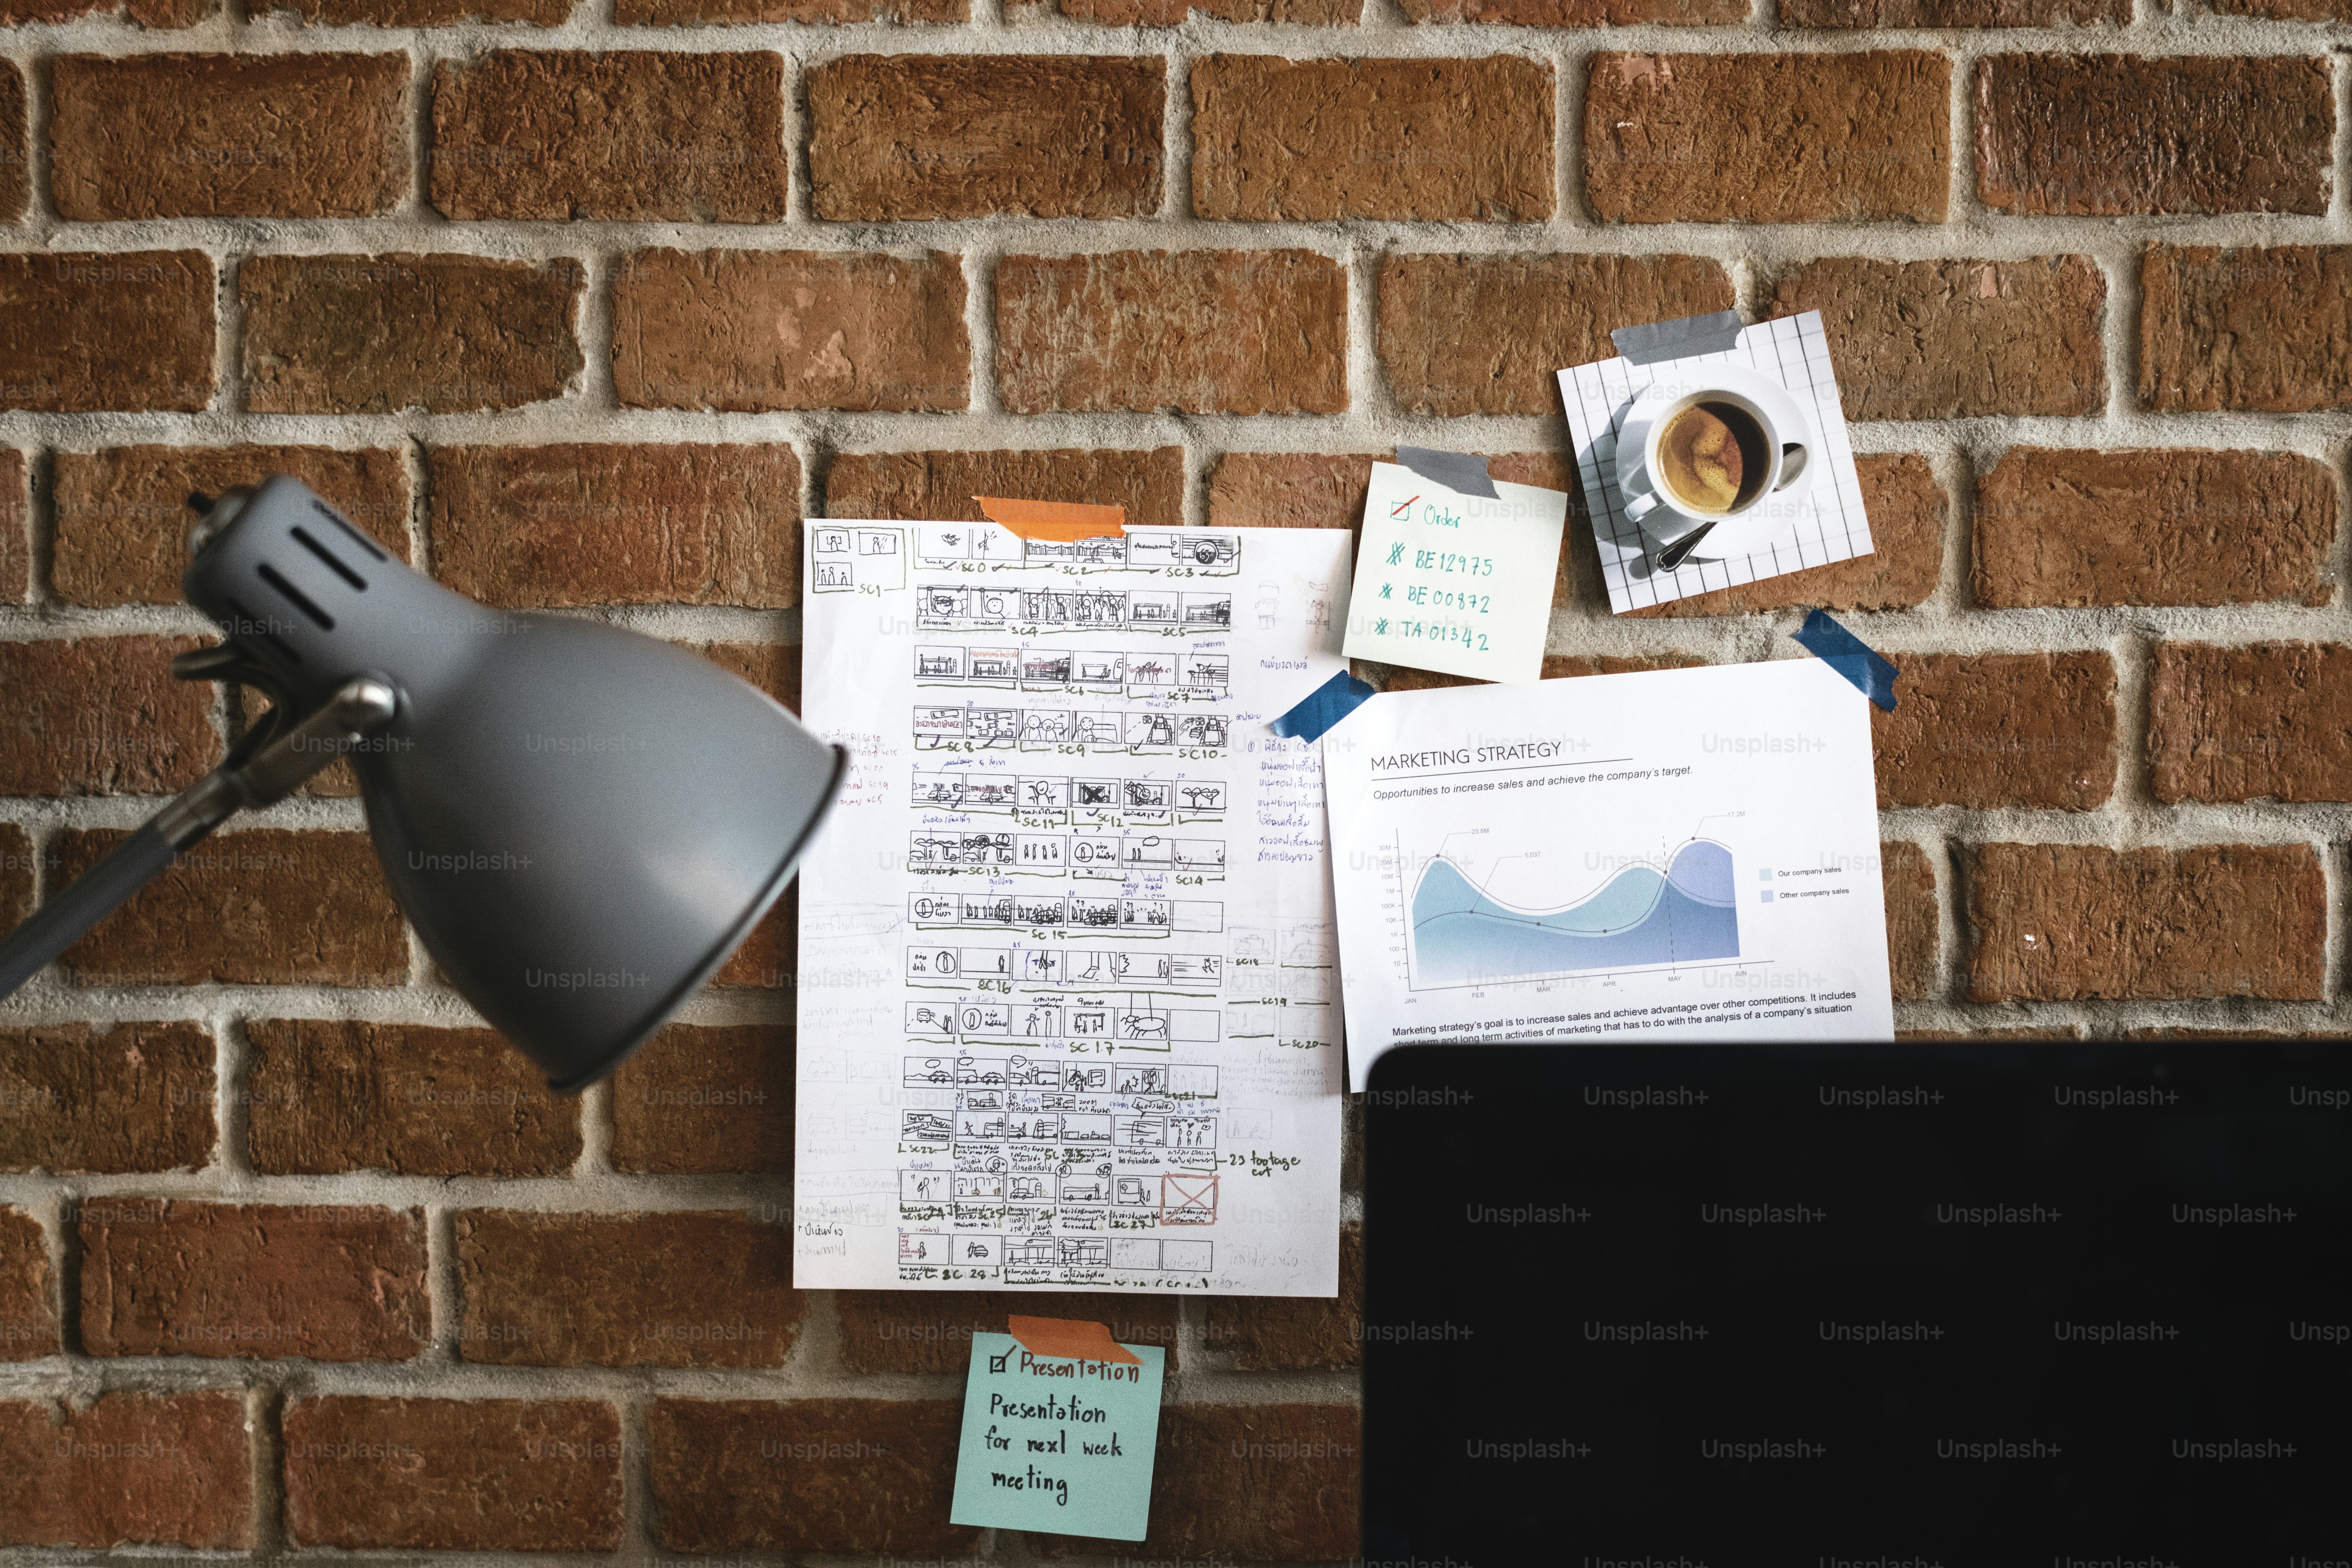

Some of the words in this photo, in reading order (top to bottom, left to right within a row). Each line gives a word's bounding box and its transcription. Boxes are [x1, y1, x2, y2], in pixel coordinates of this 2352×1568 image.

[1425, 504, 1460, 528] Order
[1162, 627, 1186, 637] SC5
[1371, 749, 1470, 771] MARKETING
[1477, 741, 1561, 762] STRATEGY
[1373, 787, 1438, 801] Opportunities
[1441, 785, 1450, 794] to
[1453, 782, 1495, 793] increase
[1498, 780, 1523, 789] sales
[1526, 777, 1544, 787] and
[1548, 774, 1586, 786] achieve
[1589, 773, 1604, 782] the
[1662, 766, 1693, 777] target.
[1392, 1026, 1436, 1036] Marketing
[1484, 1019, 1503, 1029] goal
[1527, 1015, 1565, 1025] increase
[1568, 1013, 1591, 1022] sales
[1594, 1010, 1611, 1019] and
[1613, 1008, 1648, 1018] achieve
[1651, 1004, 1698, 1015] advantage
[1700, 1002, 1719, 1011] over
[1723, 1000, 1745, 1009] other
[1749, 996, 1807, 1007] competitions.
[1810, 993, 1817, 1002] It
[1819, 991, 1856, 1001] includes
[1441, 1036, 1457, 1045] and
[1460, 1035, 1479, 1044] long
[1482, 1033, 1502, 1042] term
[1505, 1029, 1543, 1039] activities
[1546, 1027, 1554, 1036] of
[1557, 1023, 1601, 1035] marketing
[1604, 1023, 1621, 1031] that
[1624, 1021, 1640, 1029] has
[1642, 1020, 1651, 1028] to
[1667, 1017, 1685, 1026] with
[1705, 1013, 1741, 1023] analysis
[1744, 1011, 1752, 1019] of
[1814, 1004, 1852, 1014] situation
[1021, 1351, 1139, 1383] Presentation
[990, 1393, 1106, 1423] Presentation
[985, 1425, 1011, 1450] for
[1083, 1432, 1122, 1456] week
[991, 1464, 1067, 1506] meeting
